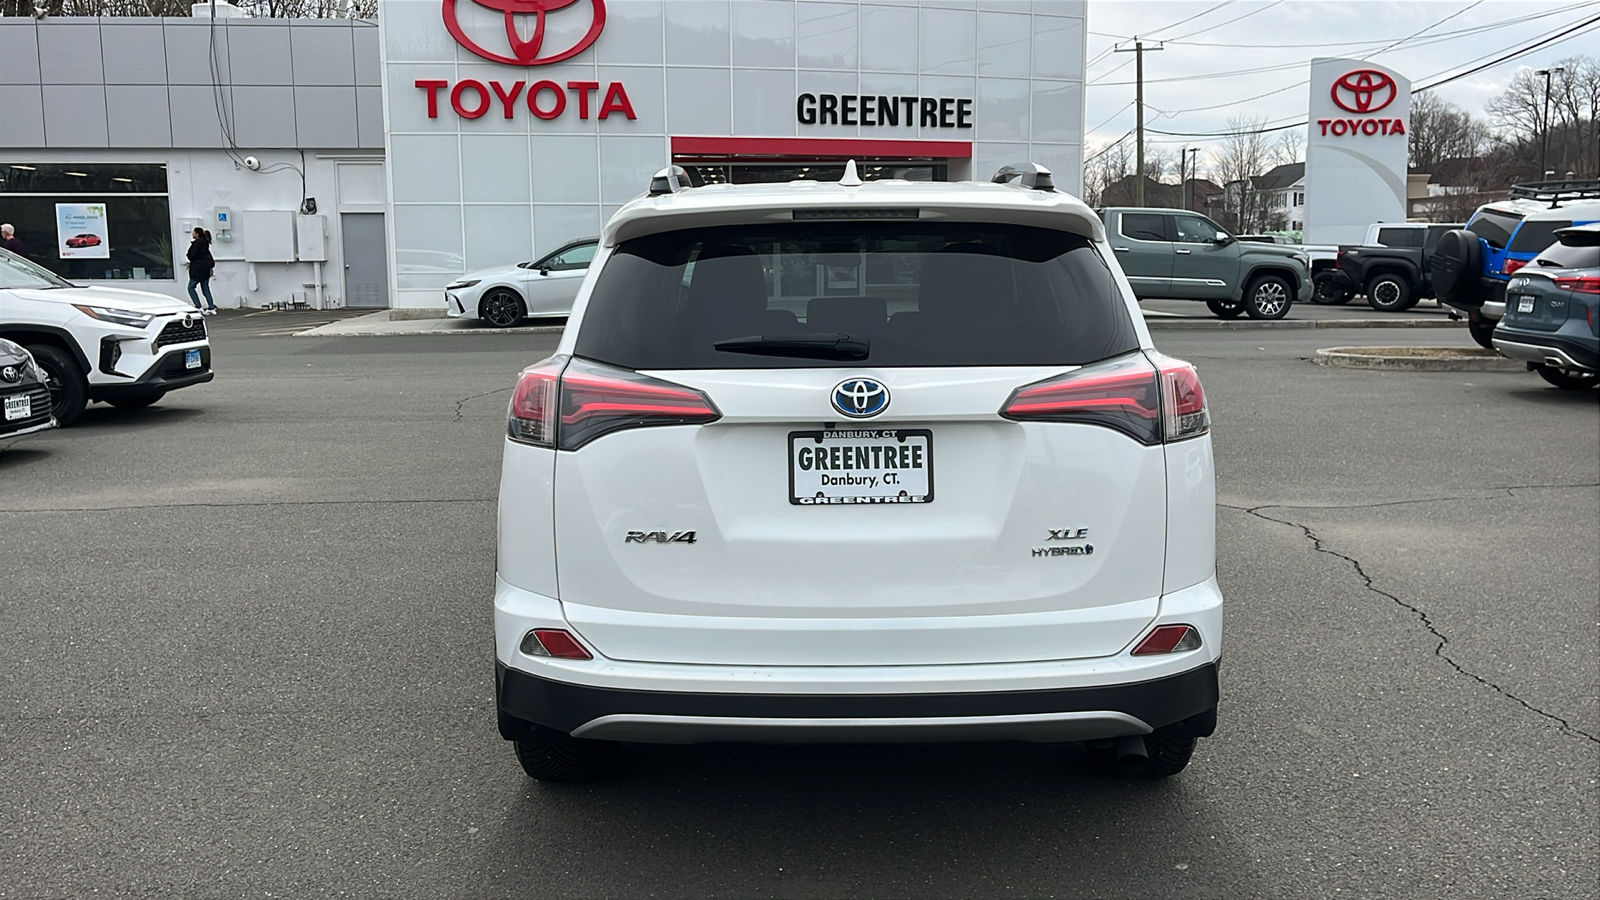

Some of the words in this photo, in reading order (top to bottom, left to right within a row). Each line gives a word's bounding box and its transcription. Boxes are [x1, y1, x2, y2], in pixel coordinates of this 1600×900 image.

[415, 79, 637, 120] TOYOTA
[797, 93, 972, 128] GREENTREE
[1317, 118, 1406, 136] TOYOTA
[823, 431, 879, 439] DANBURY,
[882, 430, 897, 438] CT
[798, 445, 923, 471] GREENTREE
[821, 473, 879, 488] Danbury,
[883, 473, 900, 485] CT.
[799, 496, 926, 504] GREENTREE
[625, 530, 697, 544] RAV4
[1045, 527, 1089, 541] XLE
[1031, 546, 1084, 557] HYBRID
